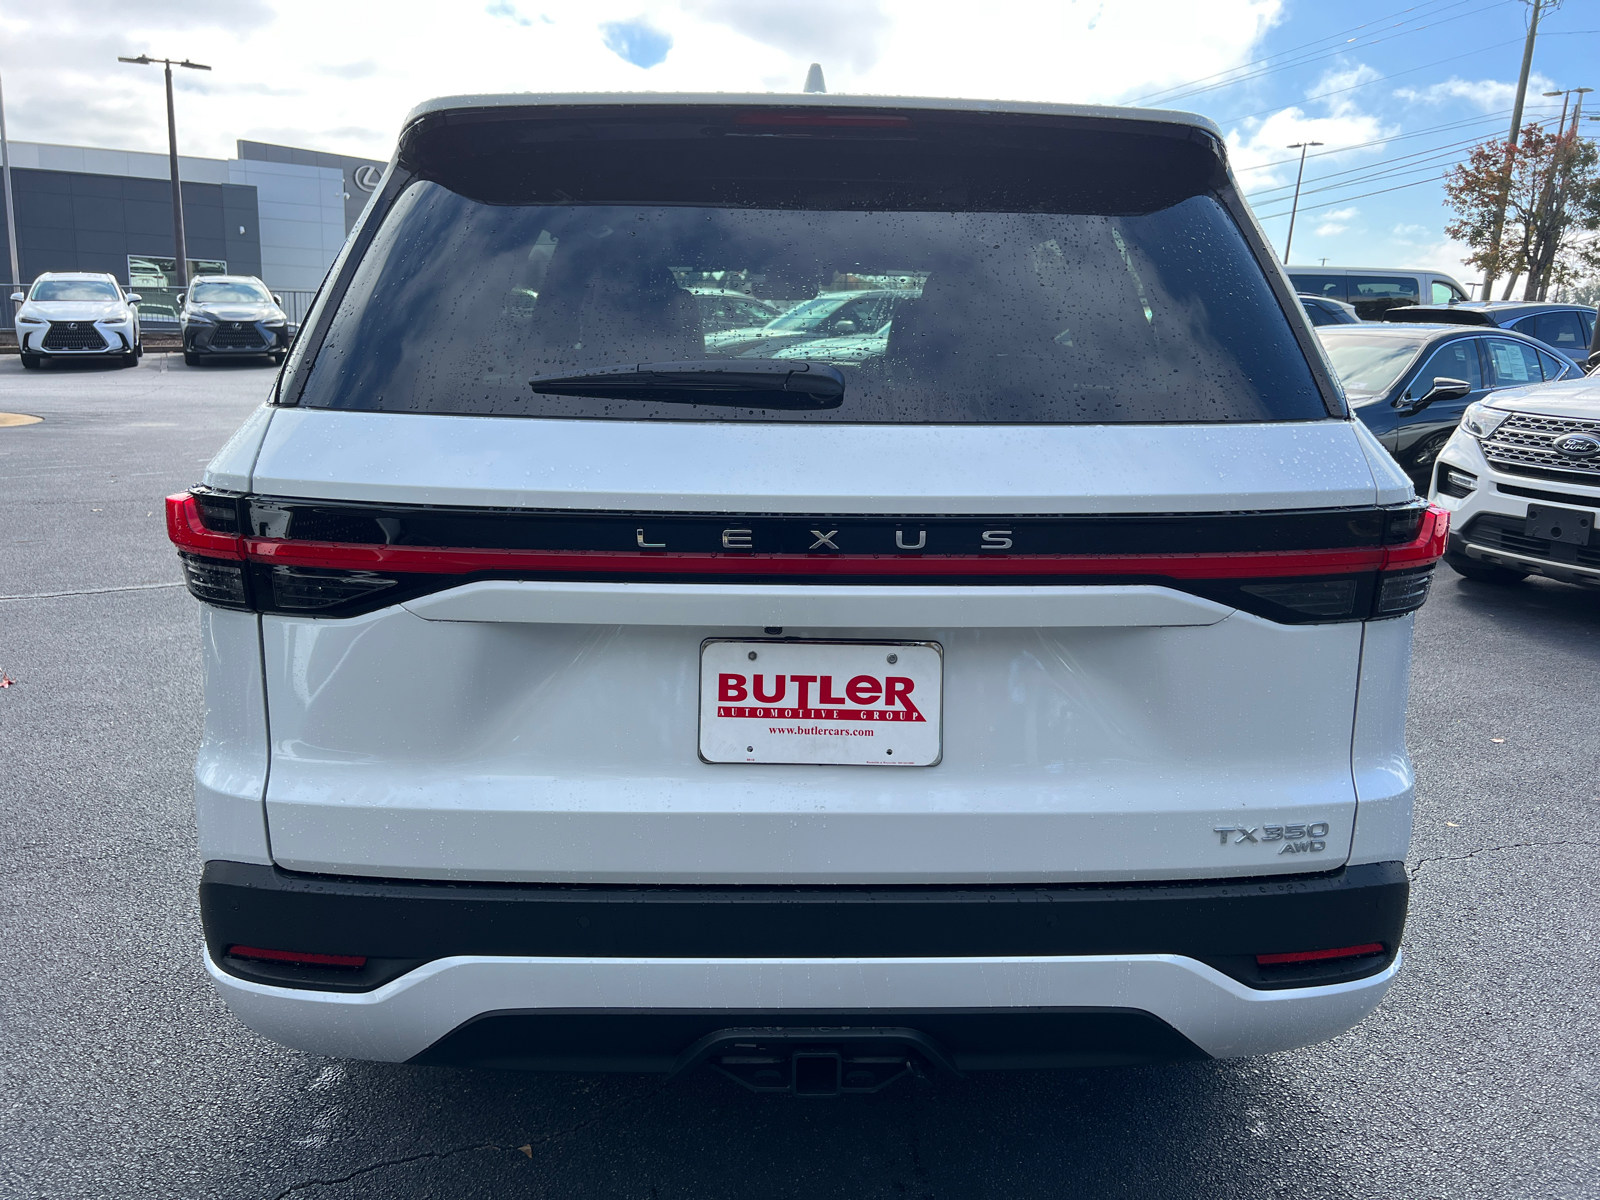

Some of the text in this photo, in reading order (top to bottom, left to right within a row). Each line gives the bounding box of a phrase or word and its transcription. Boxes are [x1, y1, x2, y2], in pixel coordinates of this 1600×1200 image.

[1562, 439, 1590, 450] Ford
[636, 528, 1013, 549] LEXUS
[718, 708, 920, 721] AUTOMOTIVE GROUP
[769, 726, 874, 737] www.butlercars.com
[1278, 840, 1326, 855] AWD
